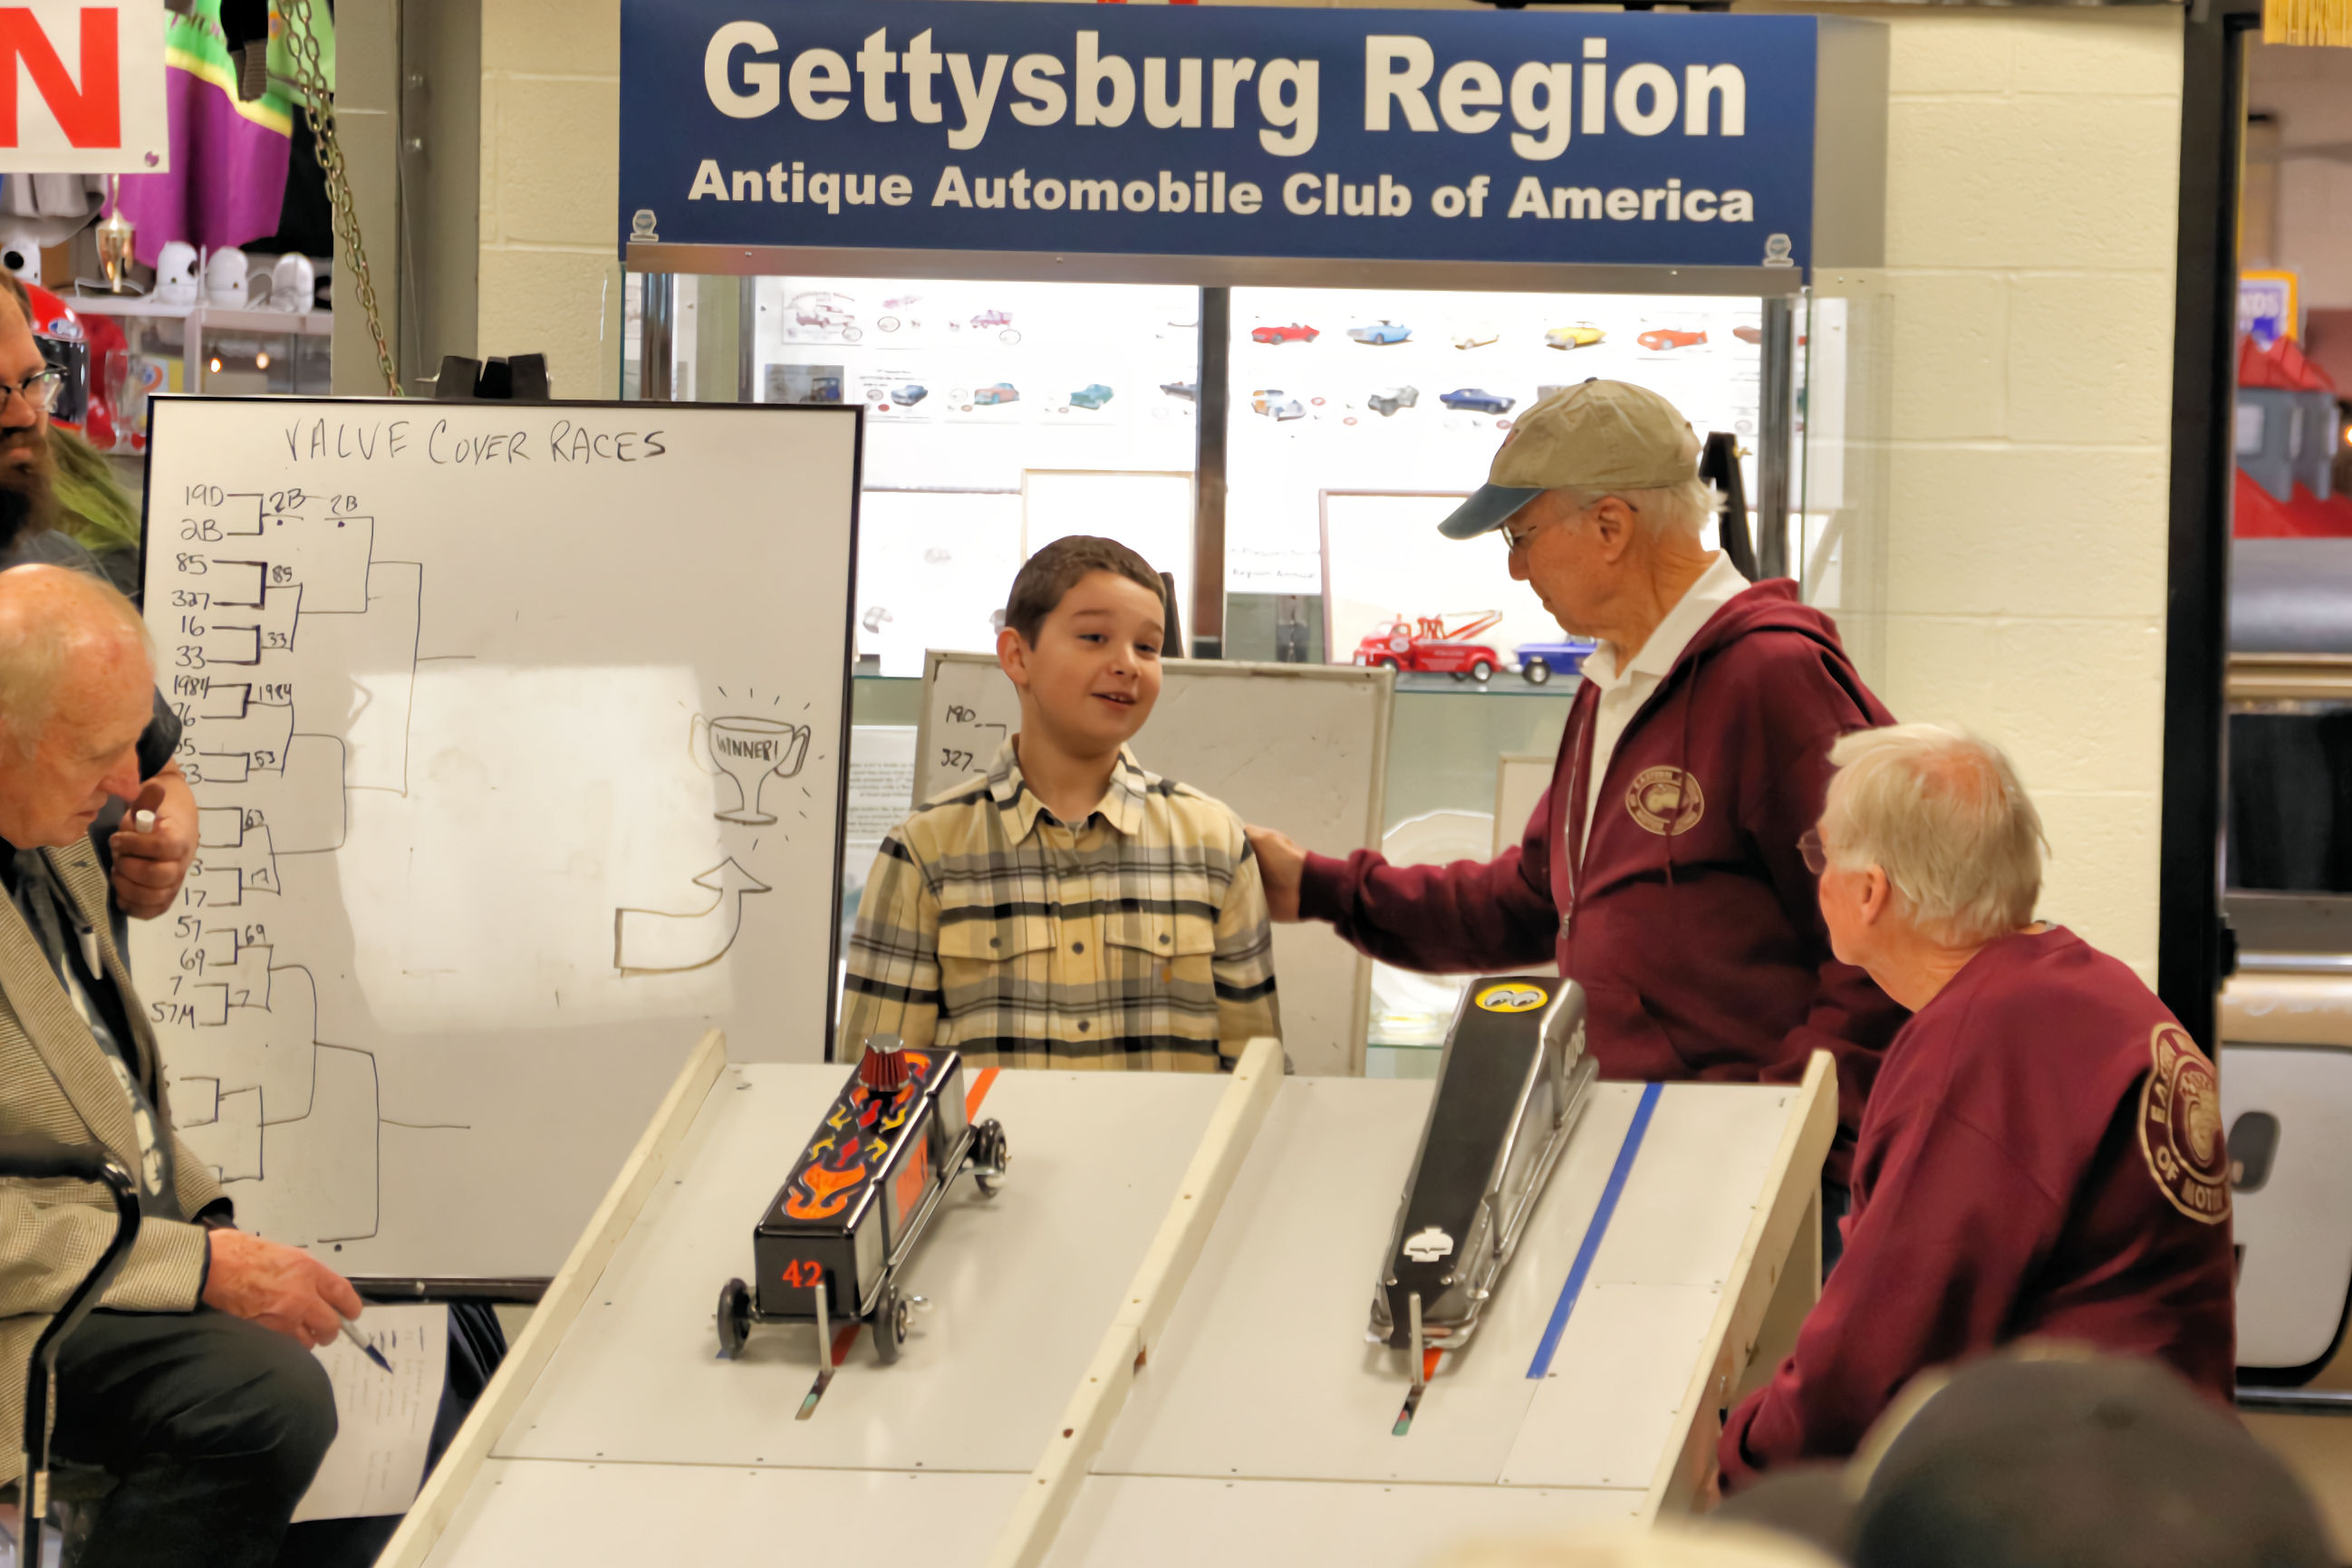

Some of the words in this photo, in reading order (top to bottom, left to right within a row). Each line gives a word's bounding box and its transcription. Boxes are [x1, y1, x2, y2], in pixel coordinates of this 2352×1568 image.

[705, 21, 1319, 156] Gettysburg
[1365, 35, 1746, 160] Region
[689, 160, 912, 214] Antique
[931, 167, 1262, 214] Automobile
[1284, 173, 1412, 216] Club
[1432, 176, 1489, 217] of
[1509, 178, 1753, 221] America
[284, 418, 410, 463] VALVE
[550, 419, 667, 465] RACES
[185, 484, 224, 507] 19D
[269, 488, 306, 513] 2B
[330, 494, 358, 516] 2B
[180, 518, 223, 543] 2B
[176, 553, 207, 575] 85
[171, 590, 210, 611] 327
[181, 615, 205, 637] 16
[267, 631, 287, 649] 33
[175, 645, 206, 669] 33
[717, 733, 778, 762] WINNER!
[940, 747, 973, 772] 327
[185, 887, 207, 908] 17
[174, 915, 201, 943] 57
[179, 948, 205, 977] 69
[169, 976, 182, 996] 7
[782, 1258, 823, 1288] 42
